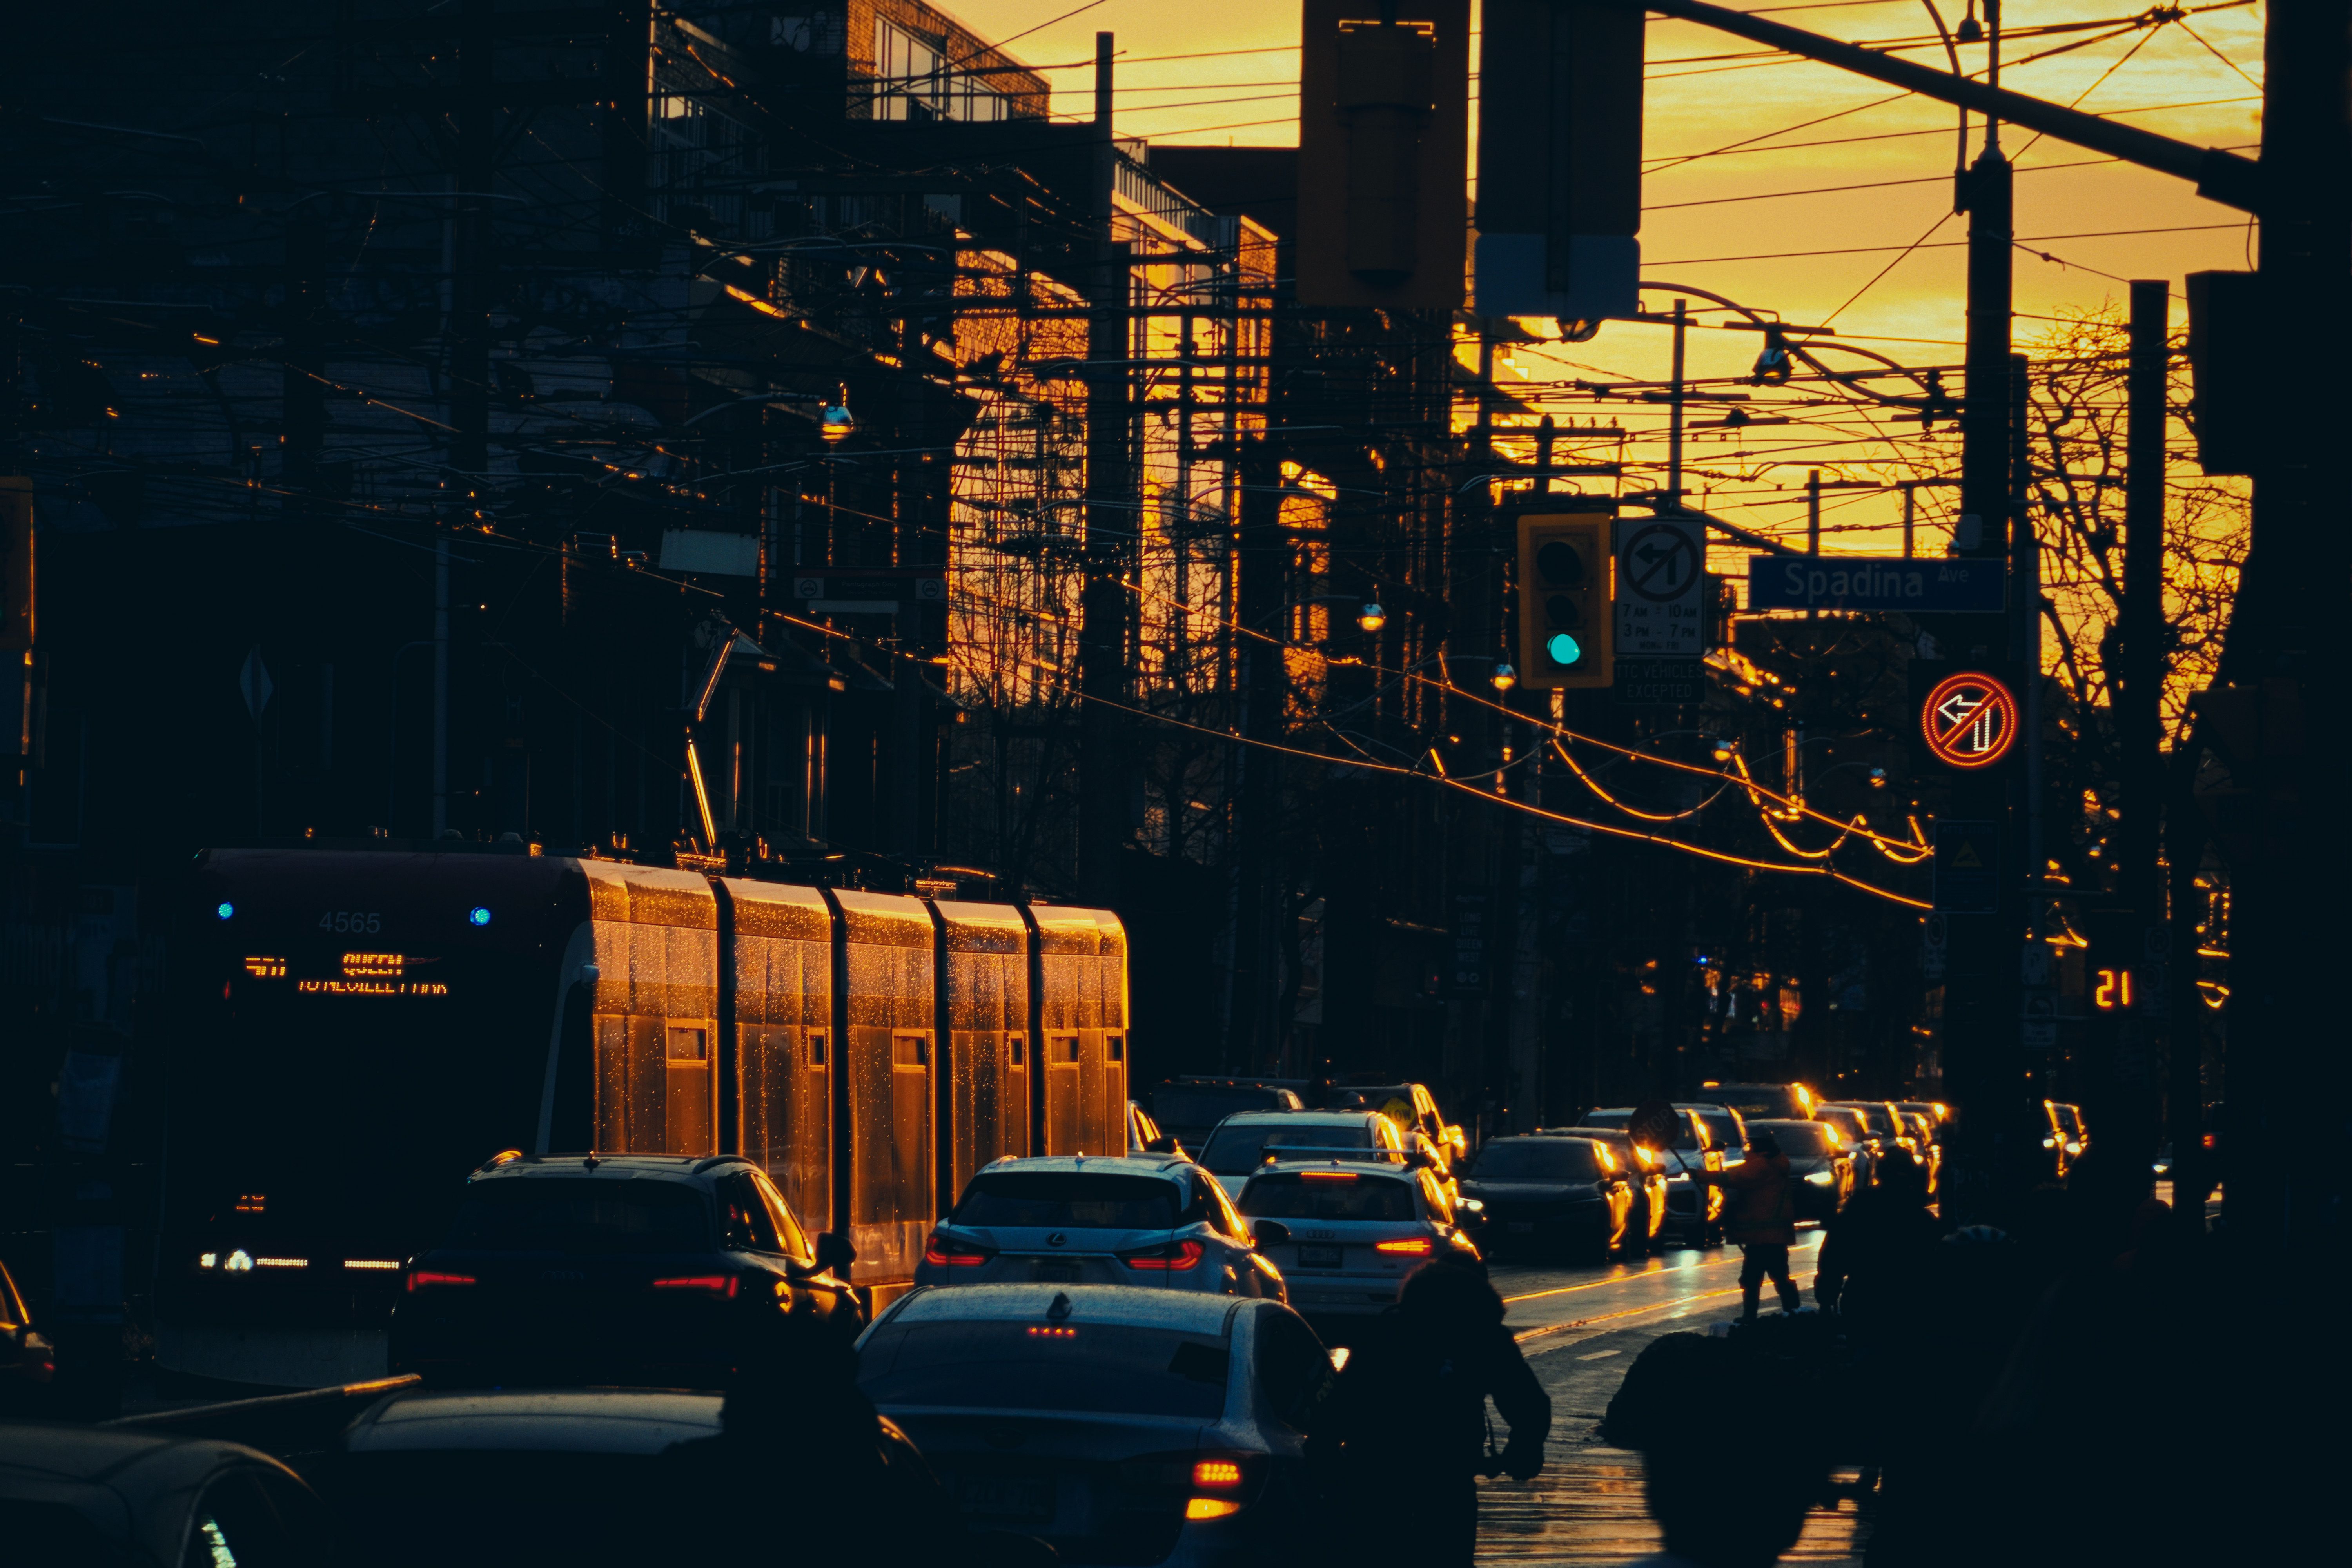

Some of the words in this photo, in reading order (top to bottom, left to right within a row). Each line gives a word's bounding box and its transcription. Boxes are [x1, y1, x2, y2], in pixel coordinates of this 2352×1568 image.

[842, 581, 881, 590] Pantograph
[882, 581, 897, 589] Only
[1785, 562, 1924, 604] Spadina
[1937, 565, 1970, 583] Ave
[1623, 603, 1631, 617] 7
[1633, 607, 1648, 617] AM
[1668, 604, 1681, 618] 10
[1683, 608, 1697, 618] AM
[1624, 623, 1632, 637] 3
[1635, 626, 1649, 637] PM
[1670, 624, 1678, 638] 7
[1681, 627, 1695, 638] PM
[1615, 664, 1638, 679] TTC
[1642, 664, 1704, 679] VEHICLES
[1626, 683, 1693, 698] EXCEPTED
[319, 911, 381, 933] 4565
[343, 954, 402, 976] QUEEN
[2096, 970, 2129, 1007] 21
[1635, 1107, 1671, 1139] STOP
